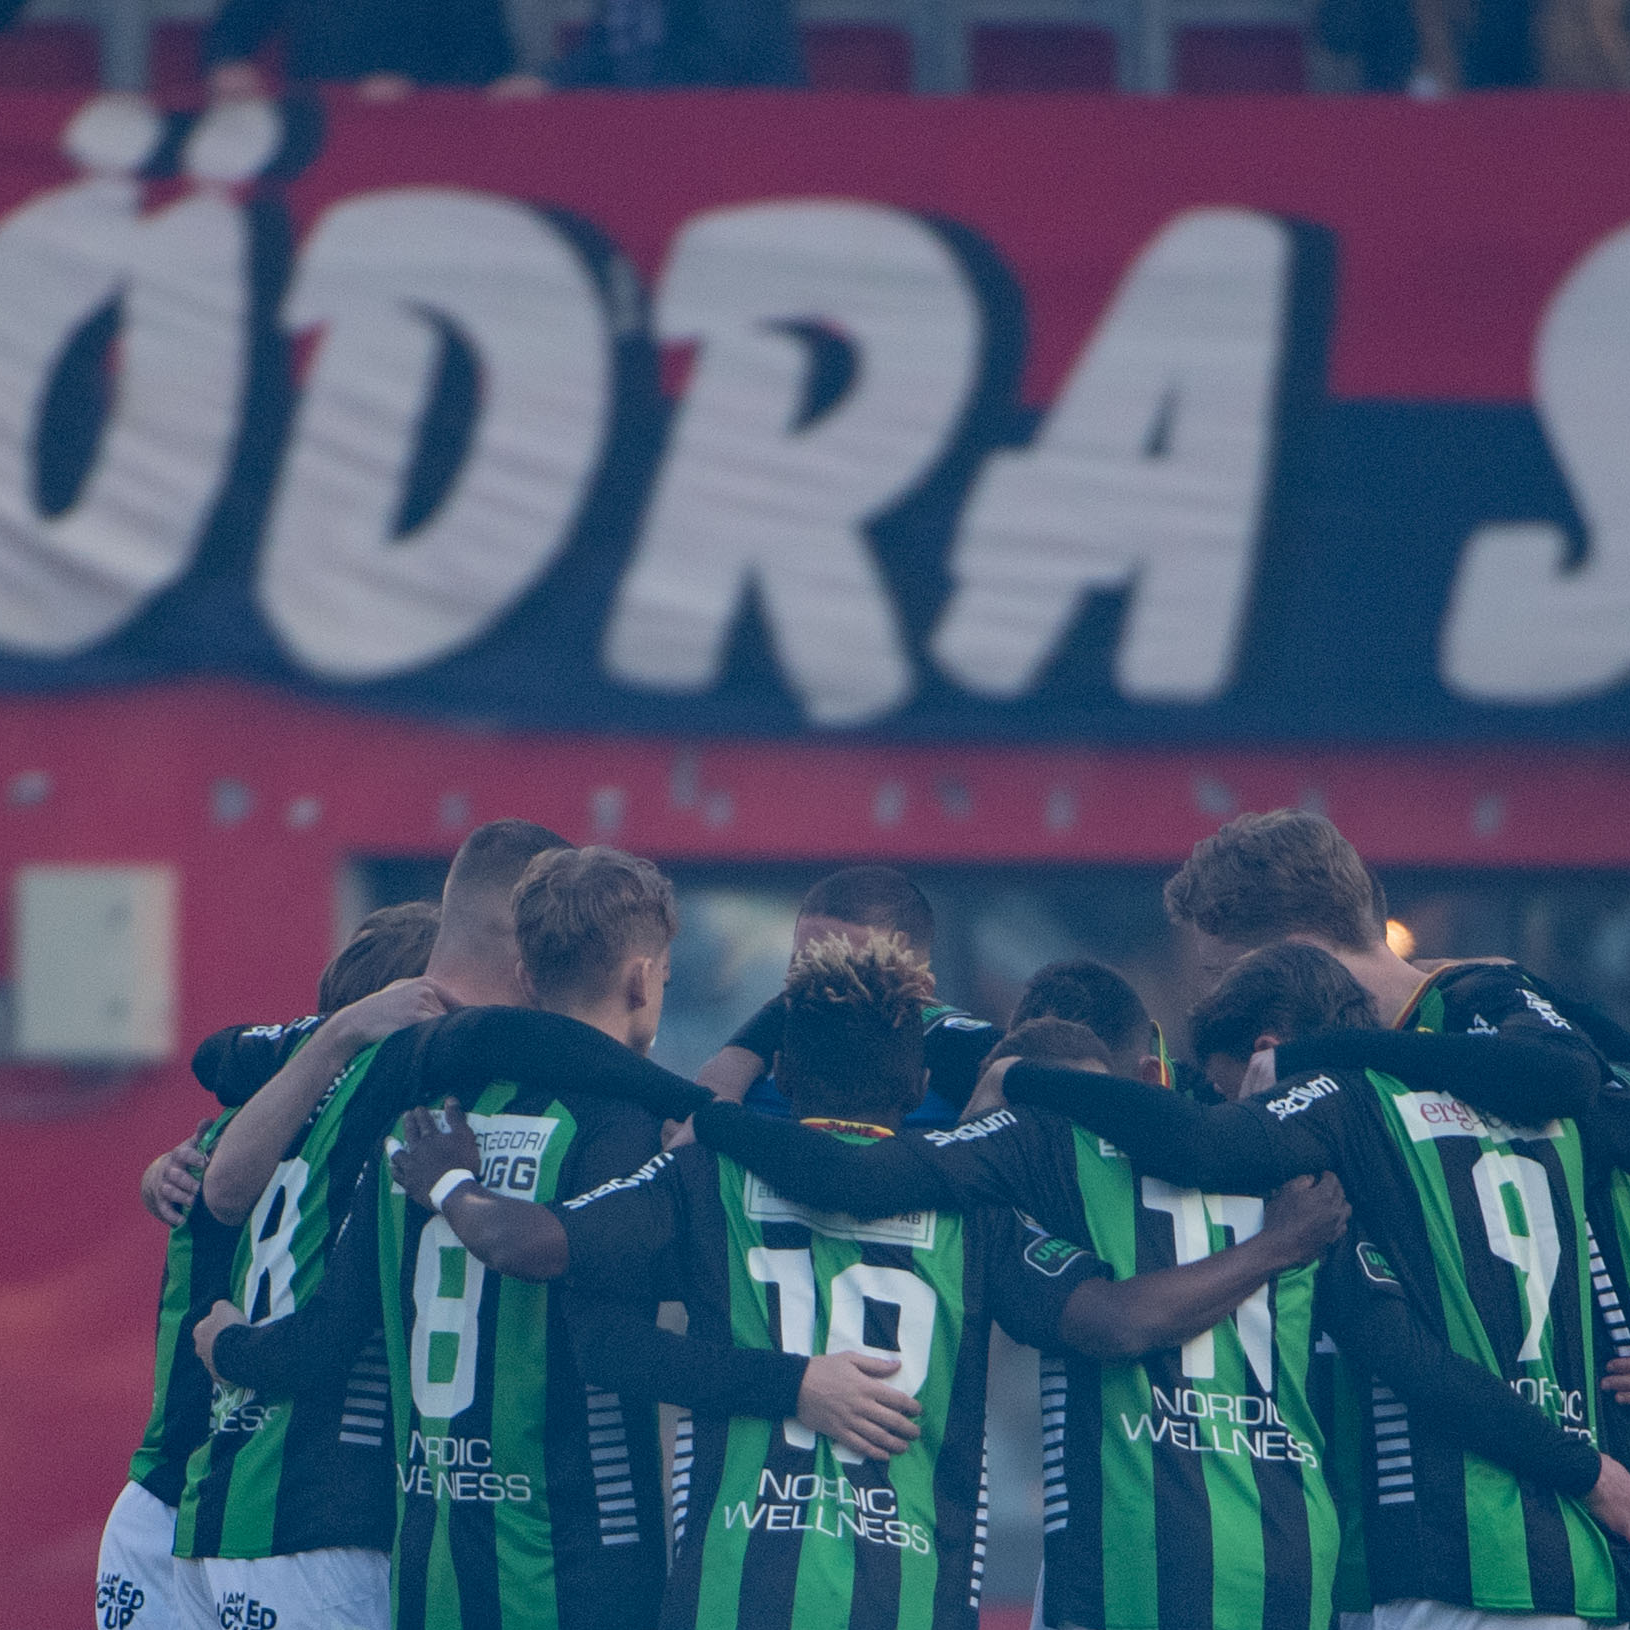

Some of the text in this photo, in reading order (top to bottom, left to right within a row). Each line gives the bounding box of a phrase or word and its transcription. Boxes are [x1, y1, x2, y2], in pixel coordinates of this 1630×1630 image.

[1472, 1150, 1561, 1363] 9
[410, 1213, 485, 1419] 8
[409, 1430, 491, 1467] NRDIC
[1121, 1413, 1318, 1469] WELLNESS
[724, 1501, 931, 1555] WELLNESS
[104, 1605, 135, 1630] UP
